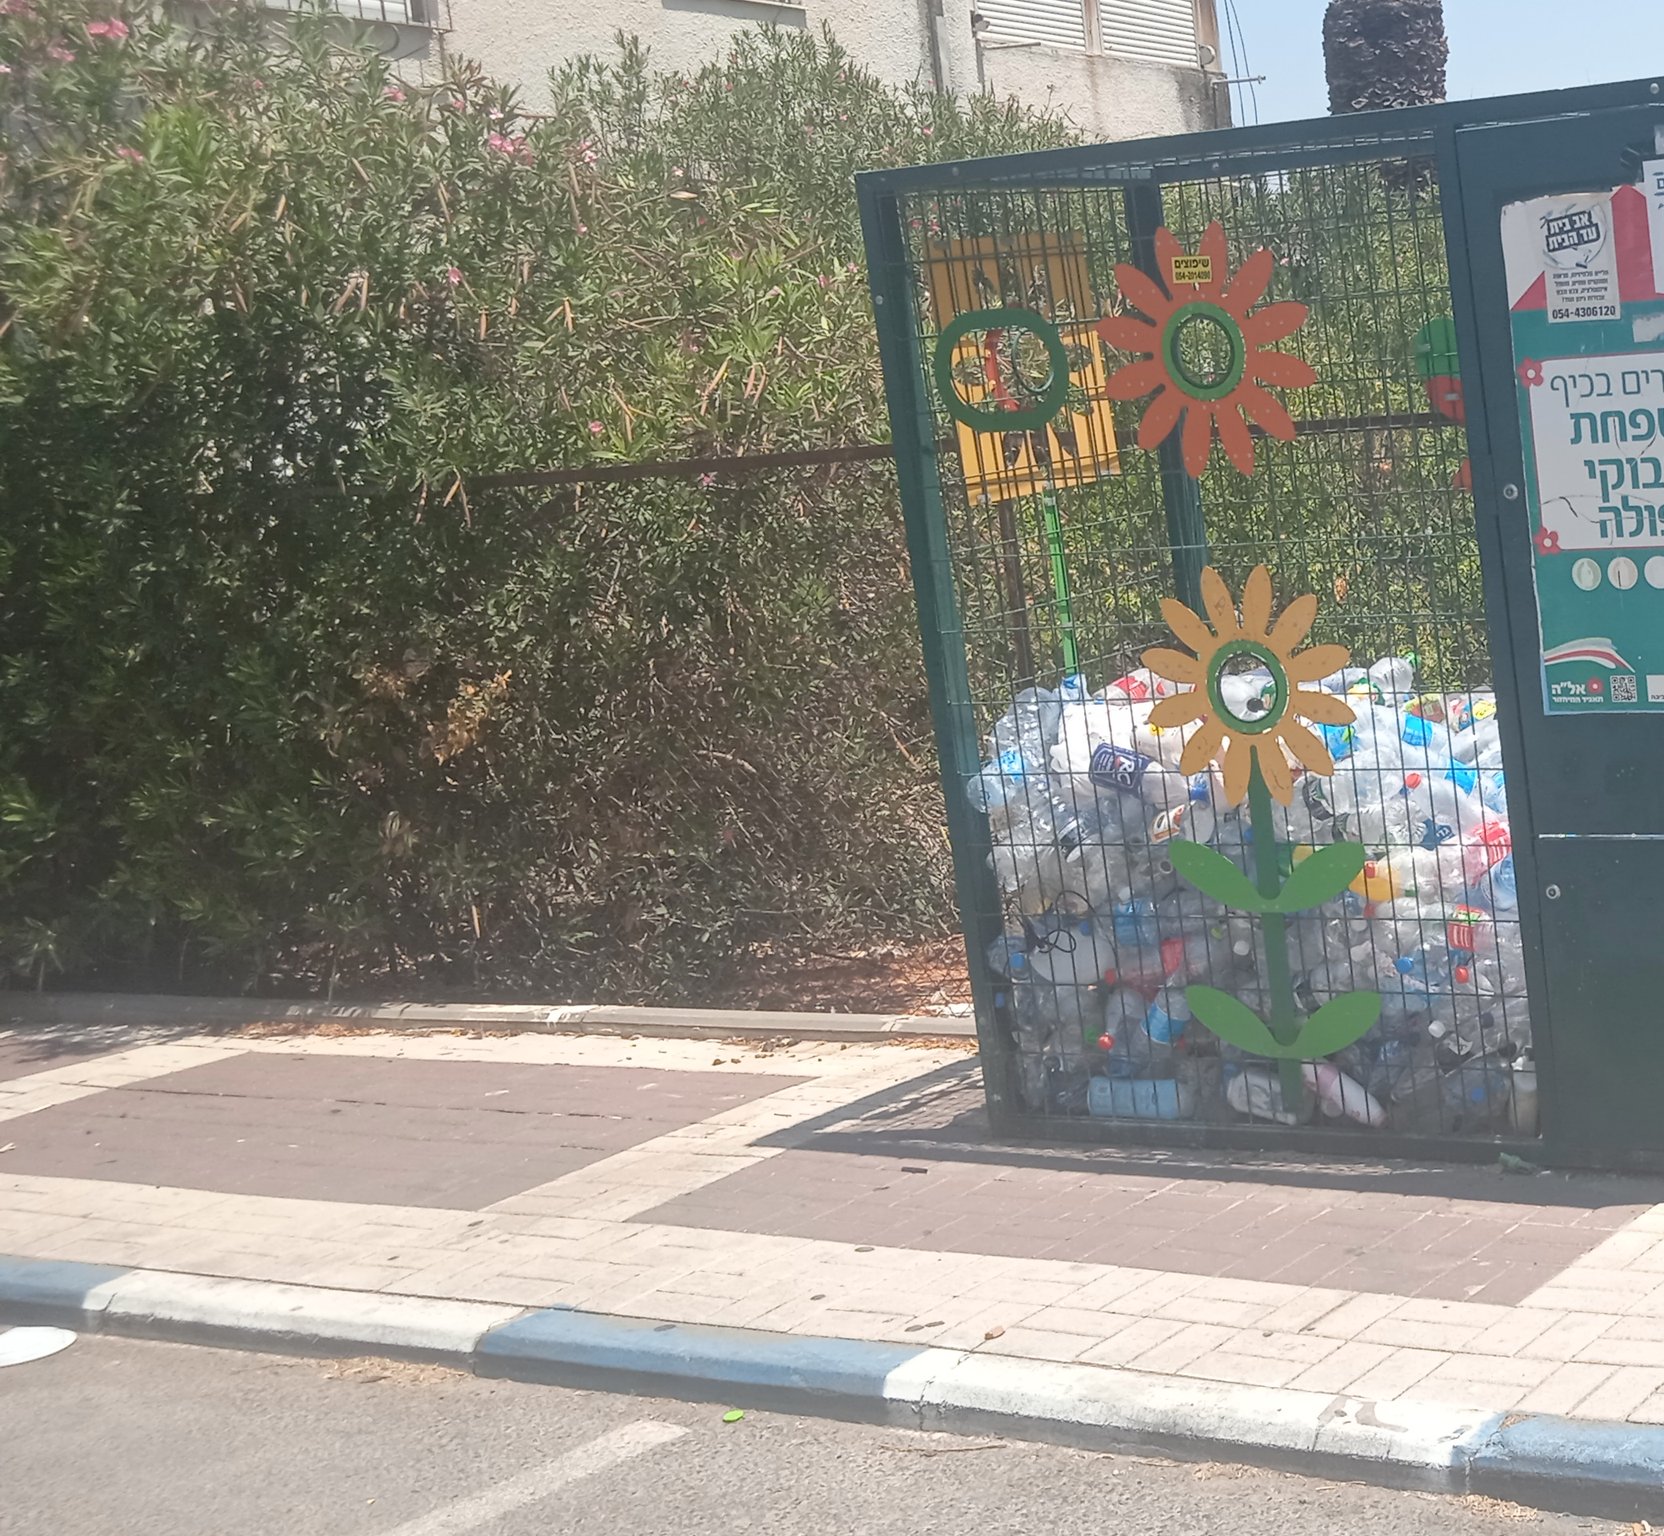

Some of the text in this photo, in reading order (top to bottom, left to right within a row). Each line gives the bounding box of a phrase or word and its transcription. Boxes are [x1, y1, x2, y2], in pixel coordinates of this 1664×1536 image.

[1550, 213, 1590, 234] אב בית
[1548, 226, 1597, 250] עד הבית
[1174, 258, 1210, 269] שיפוצים
[1552, 305, 1616, 319] 054-4306120
[1550, 370, 1613, 408] בכיף
